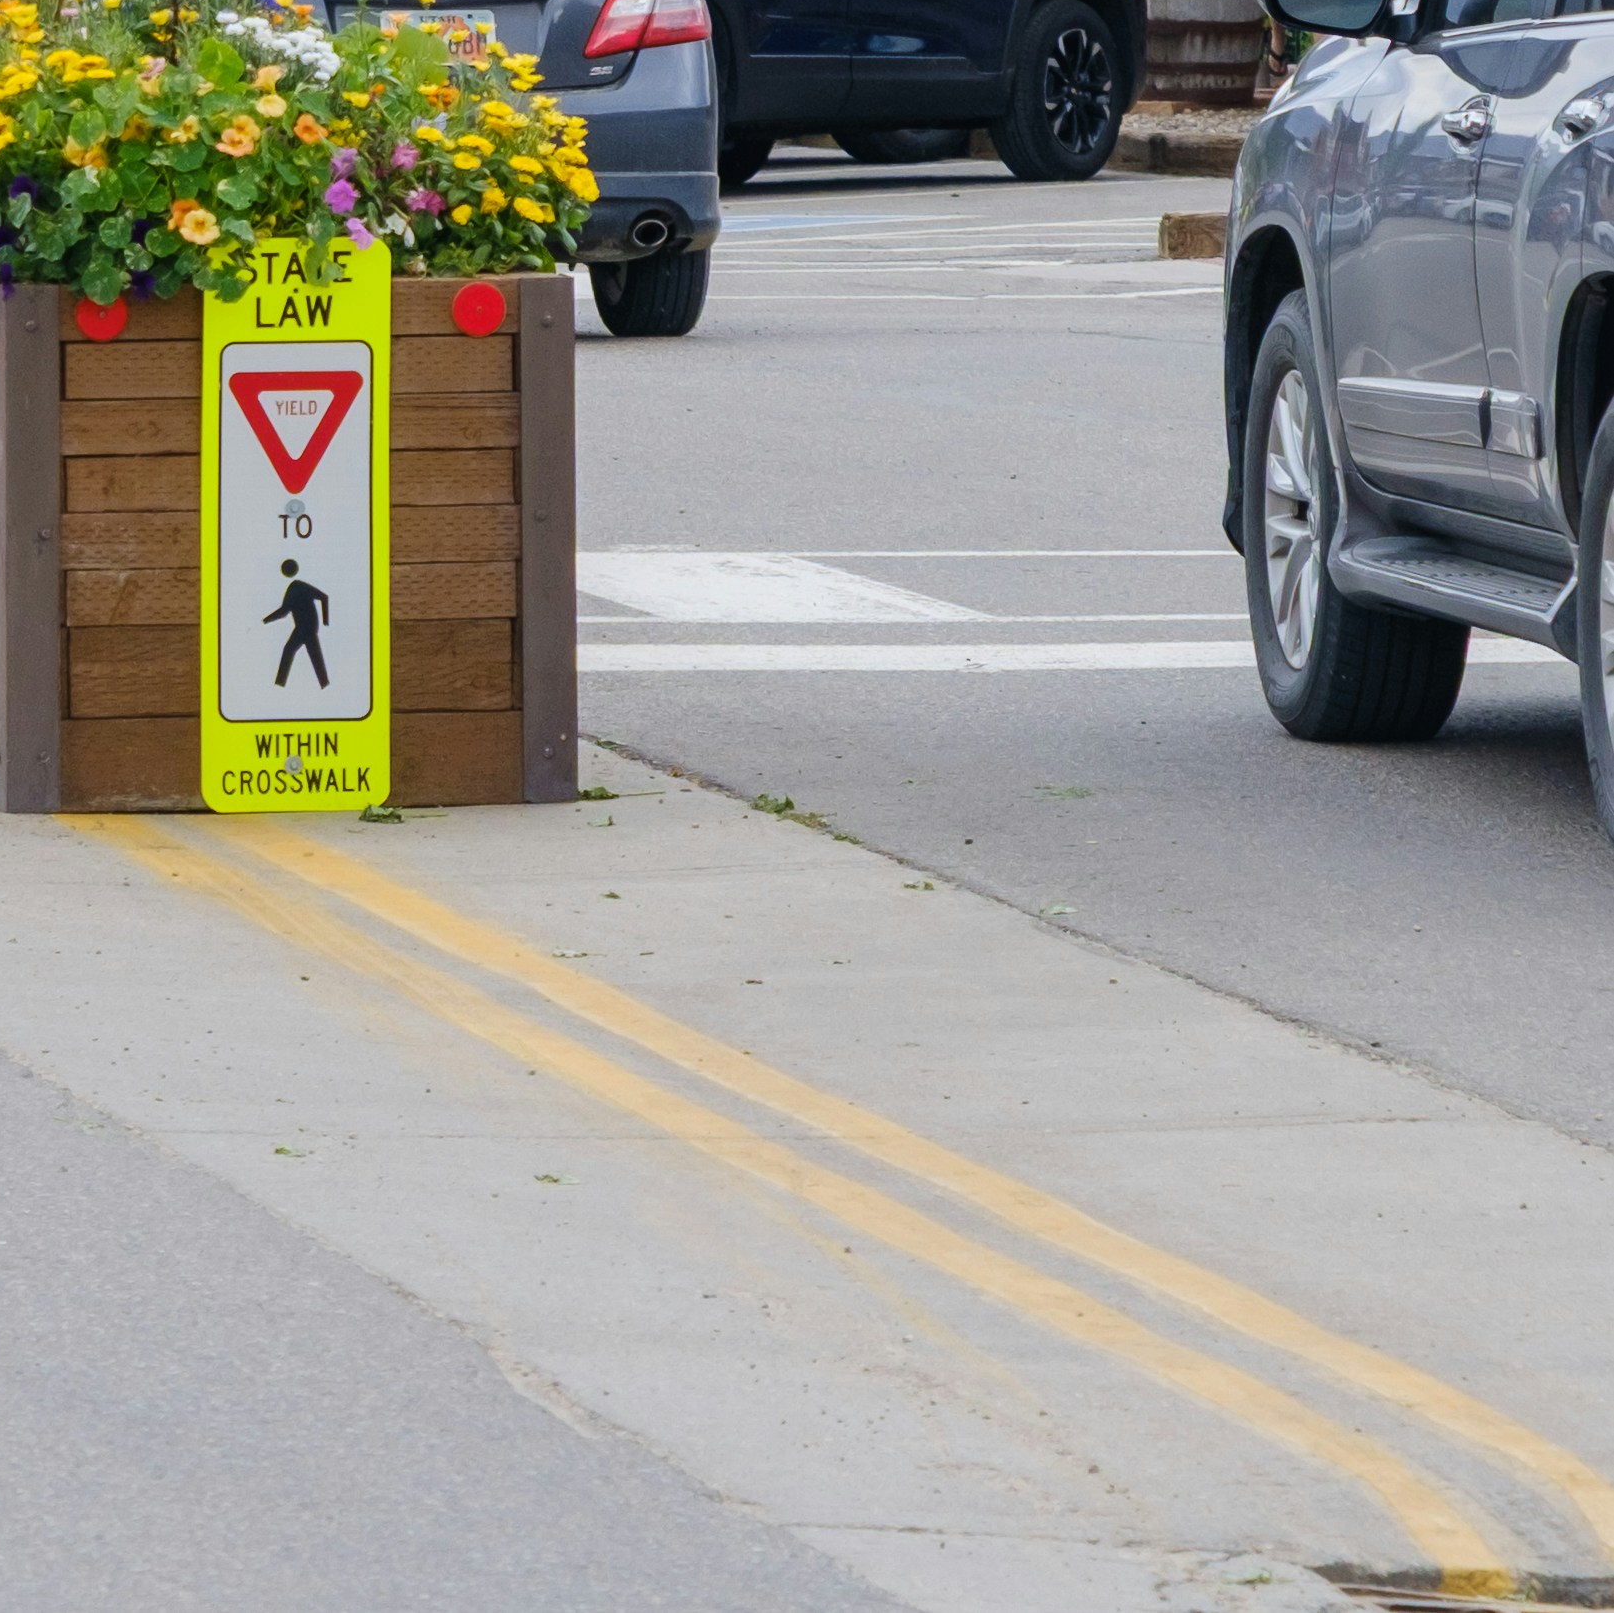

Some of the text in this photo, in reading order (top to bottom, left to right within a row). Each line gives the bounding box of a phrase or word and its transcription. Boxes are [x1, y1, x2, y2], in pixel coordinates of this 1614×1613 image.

[243, 250, 353, 285] STAE
[256, 295, 333, 328] LAW
[275, 399, 318, 416] YIELD
[278, 514, 313, 539] TO
[255, 732, 339, 758] WITHIN
[222, 767, 372, 796] CROSSWALK
